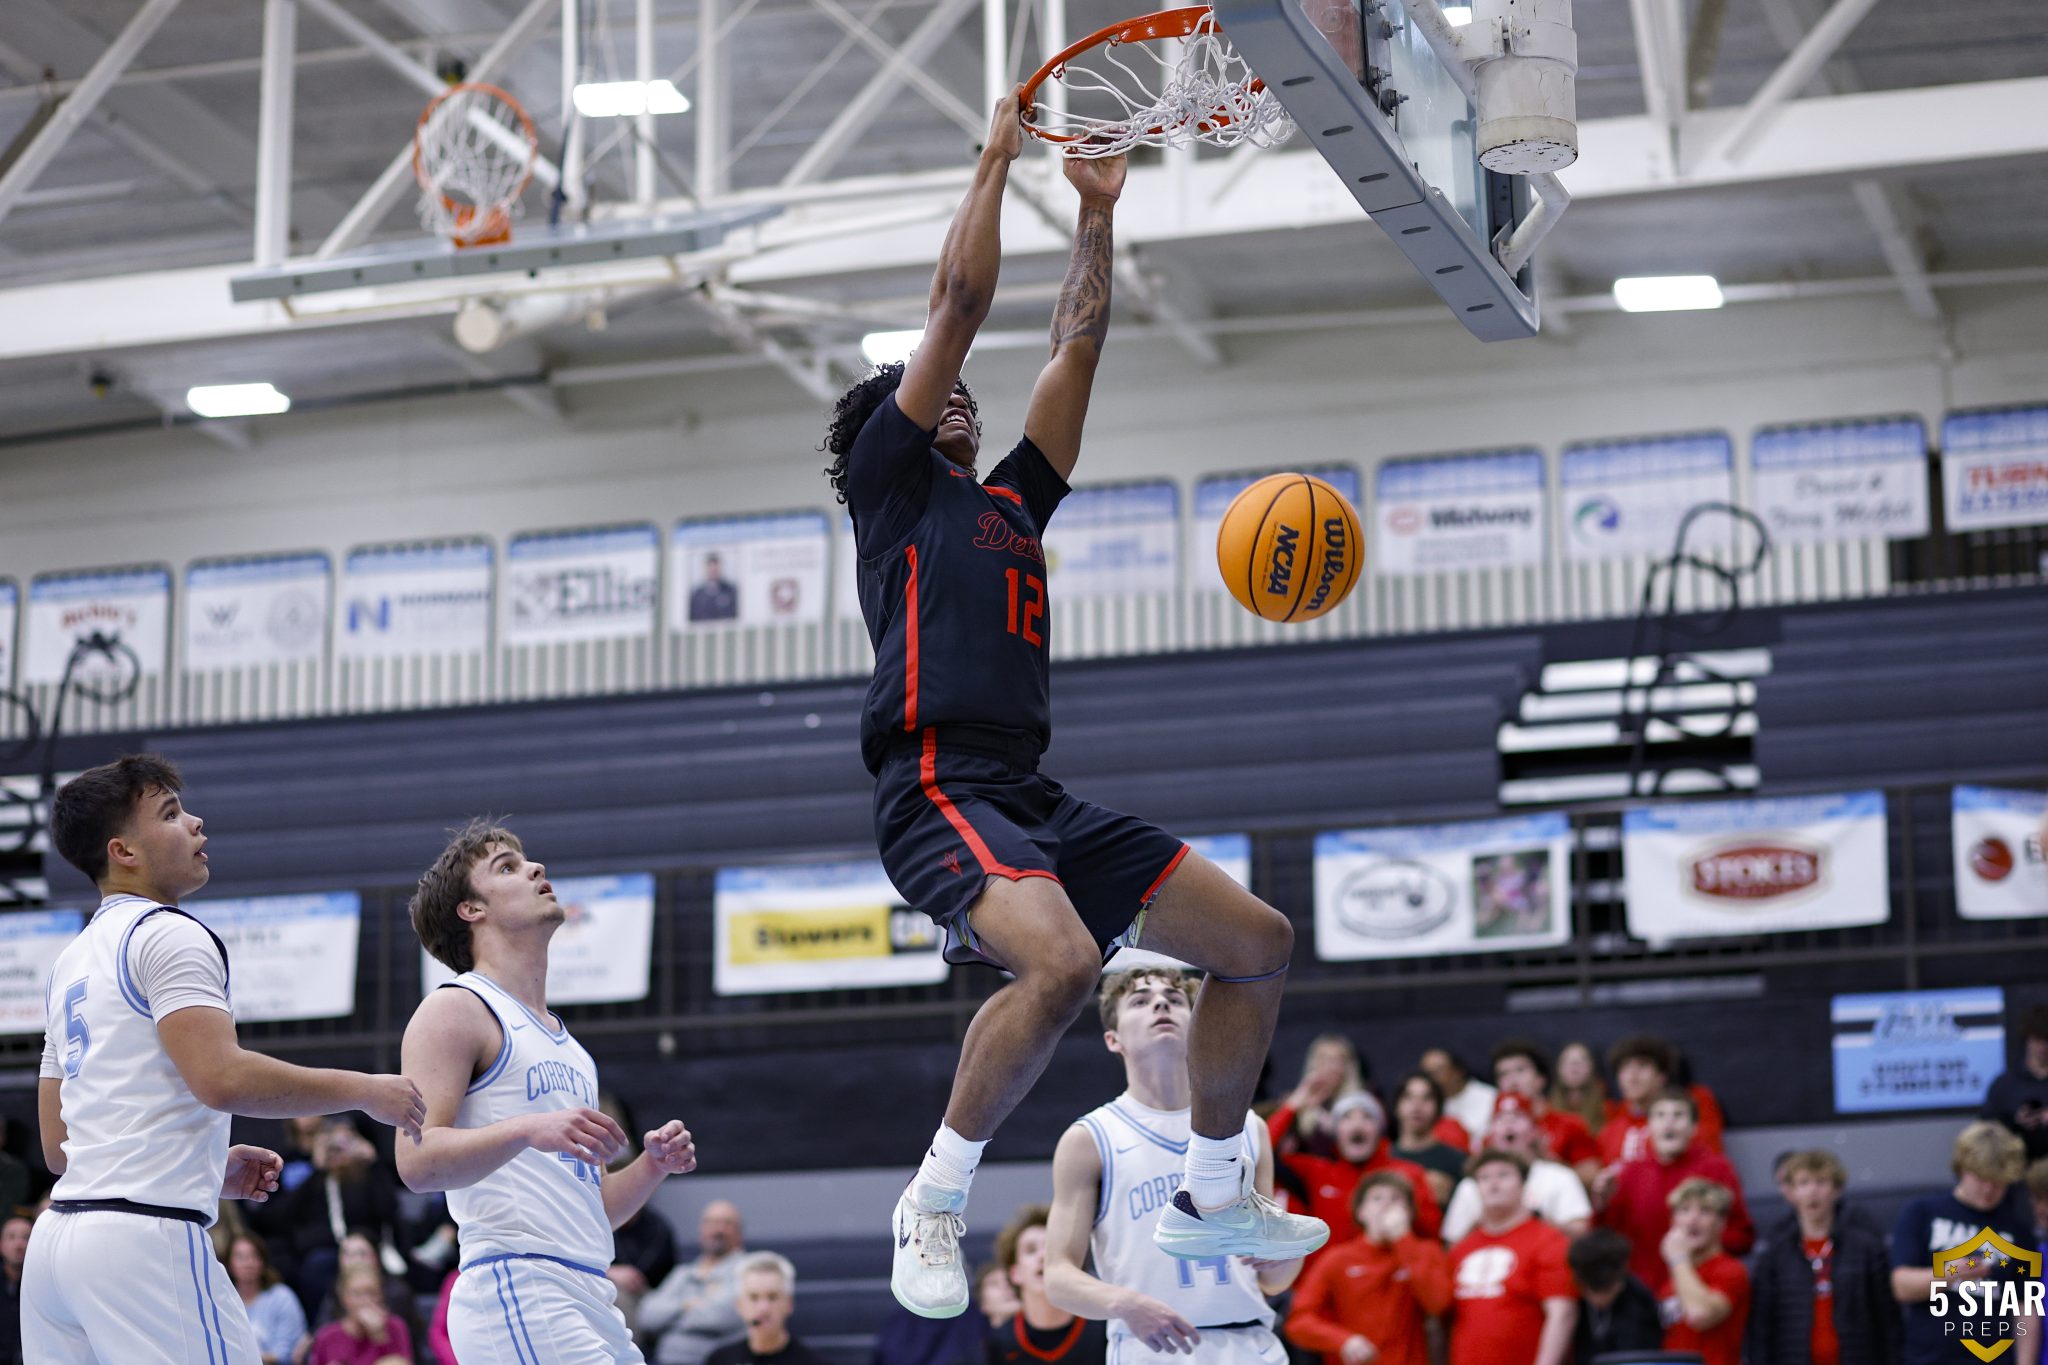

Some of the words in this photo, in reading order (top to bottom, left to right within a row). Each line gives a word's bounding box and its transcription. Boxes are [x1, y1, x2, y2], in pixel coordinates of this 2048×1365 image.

[1267, 523, 1300, 597] NCAA
[1302, 517, 1346, 612] Wilson
[1005, 567, 1044, 649] 12
[1699, 853, 1814, 890] STOKES
[63, 974, 92, 1081] 5
